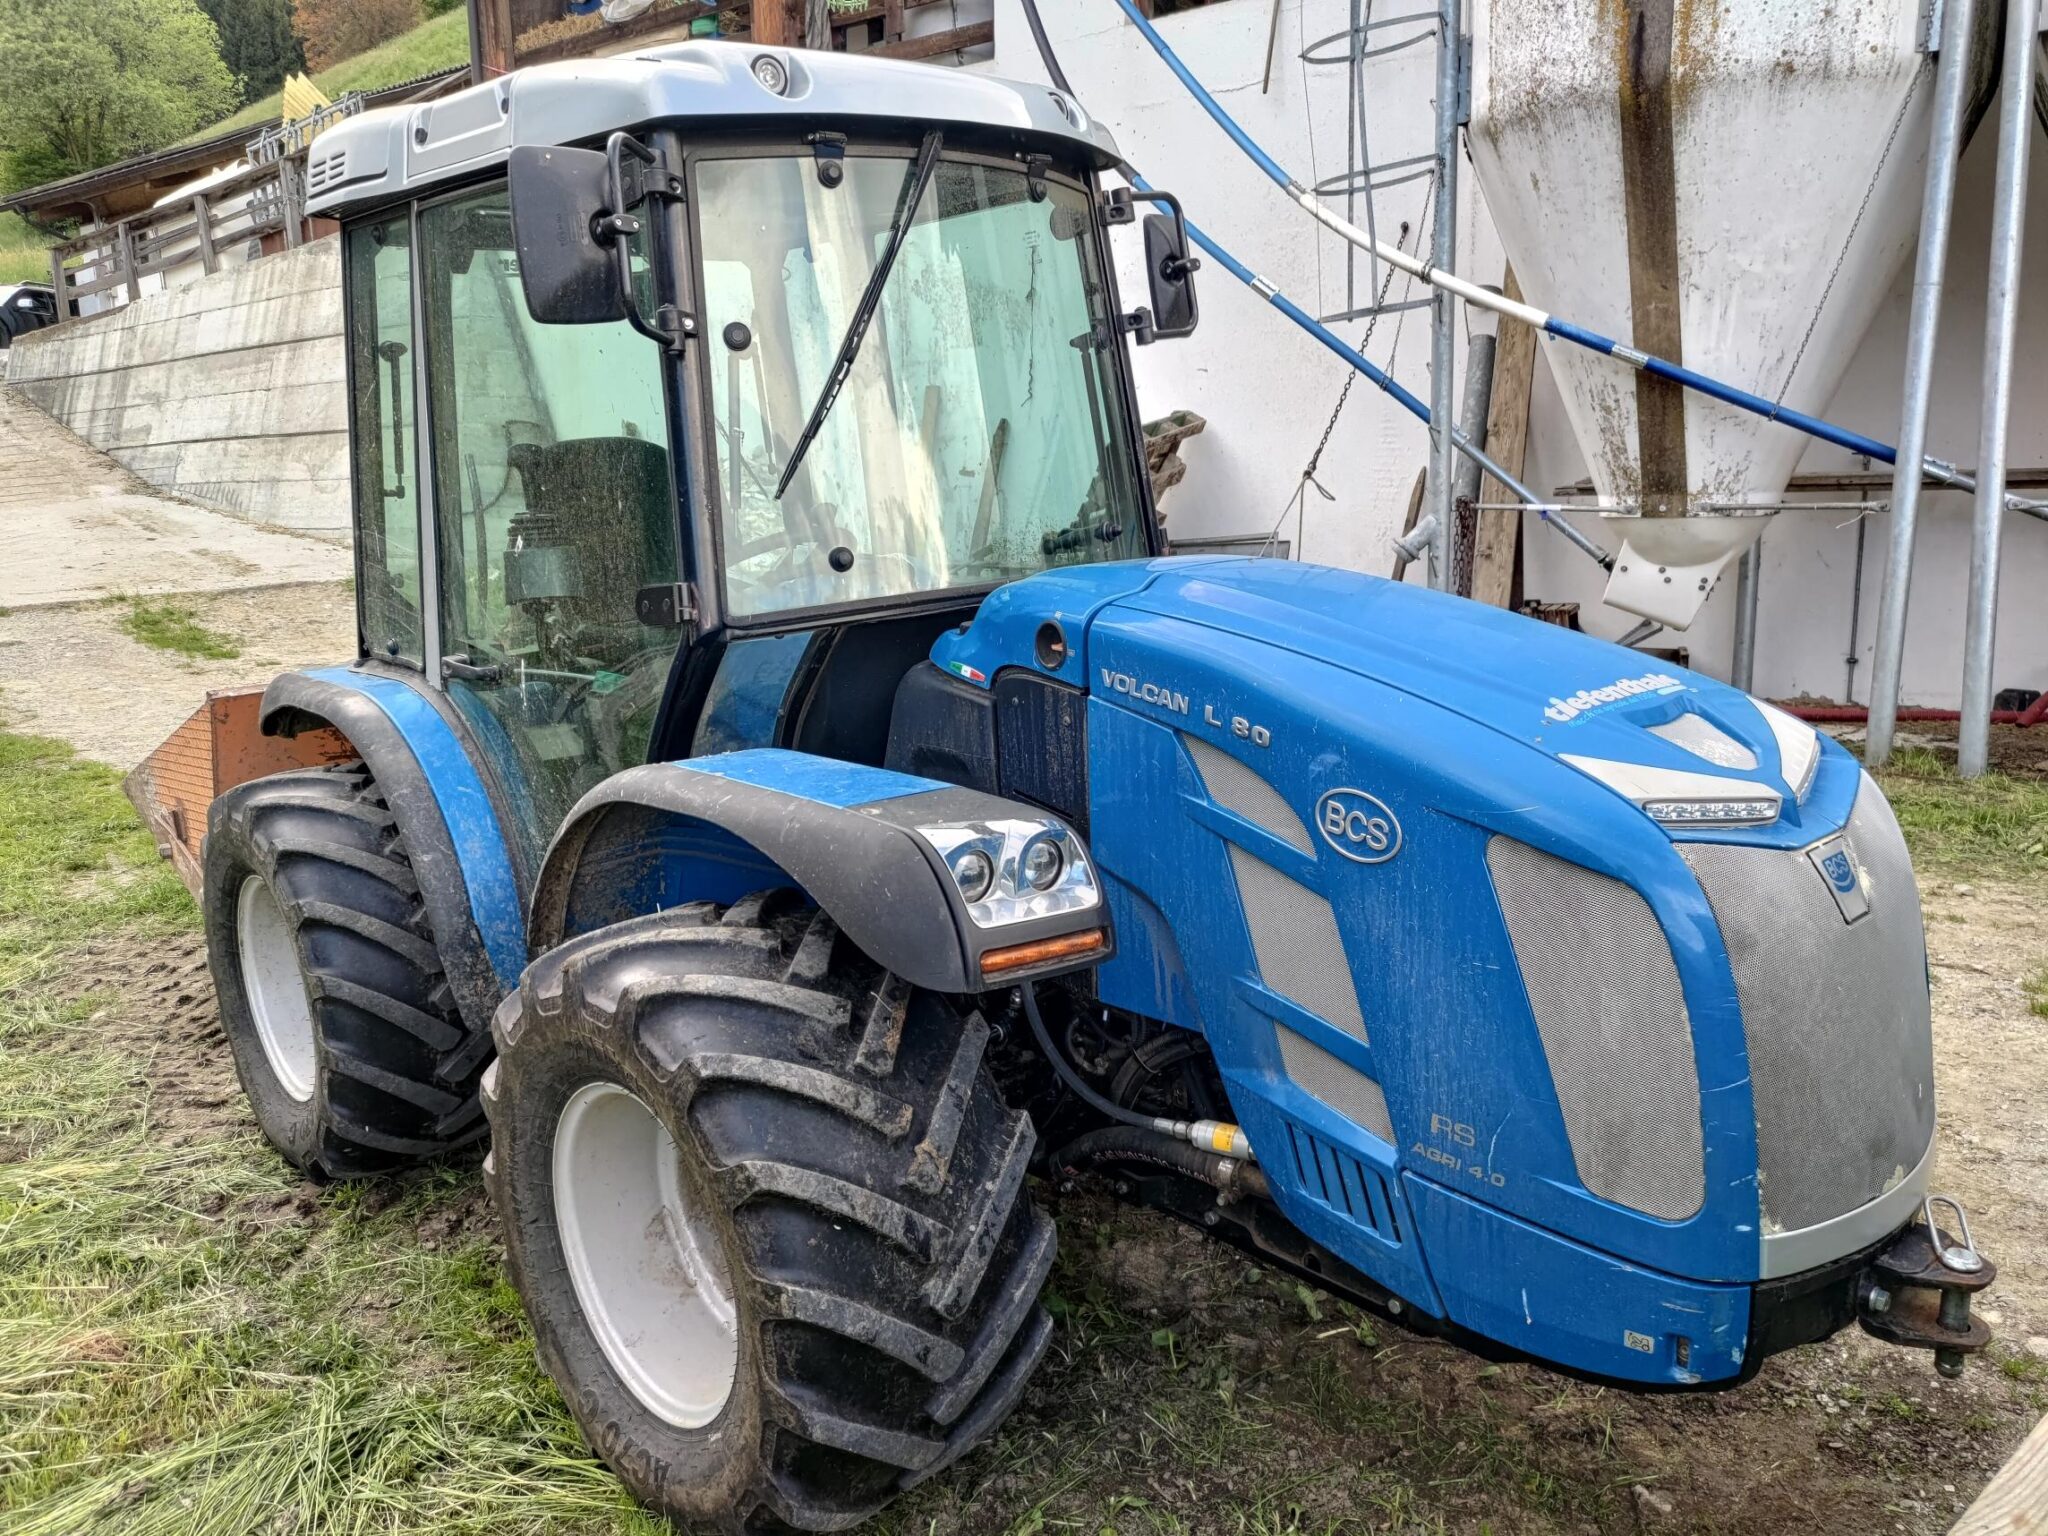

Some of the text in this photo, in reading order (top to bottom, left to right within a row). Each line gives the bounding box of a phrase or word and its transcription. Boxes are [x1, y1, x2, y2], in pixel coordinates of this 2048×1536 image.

[1101, 668, 1271, 748] VOLCAN L 80
[1325, 800, 1389, 851] BCS
[1824, 854, 1849, 879] BCS
[1430, 1112, 1476, 1147] RS
[1410, 1141, 1506, 1188] AGRI 4.0
